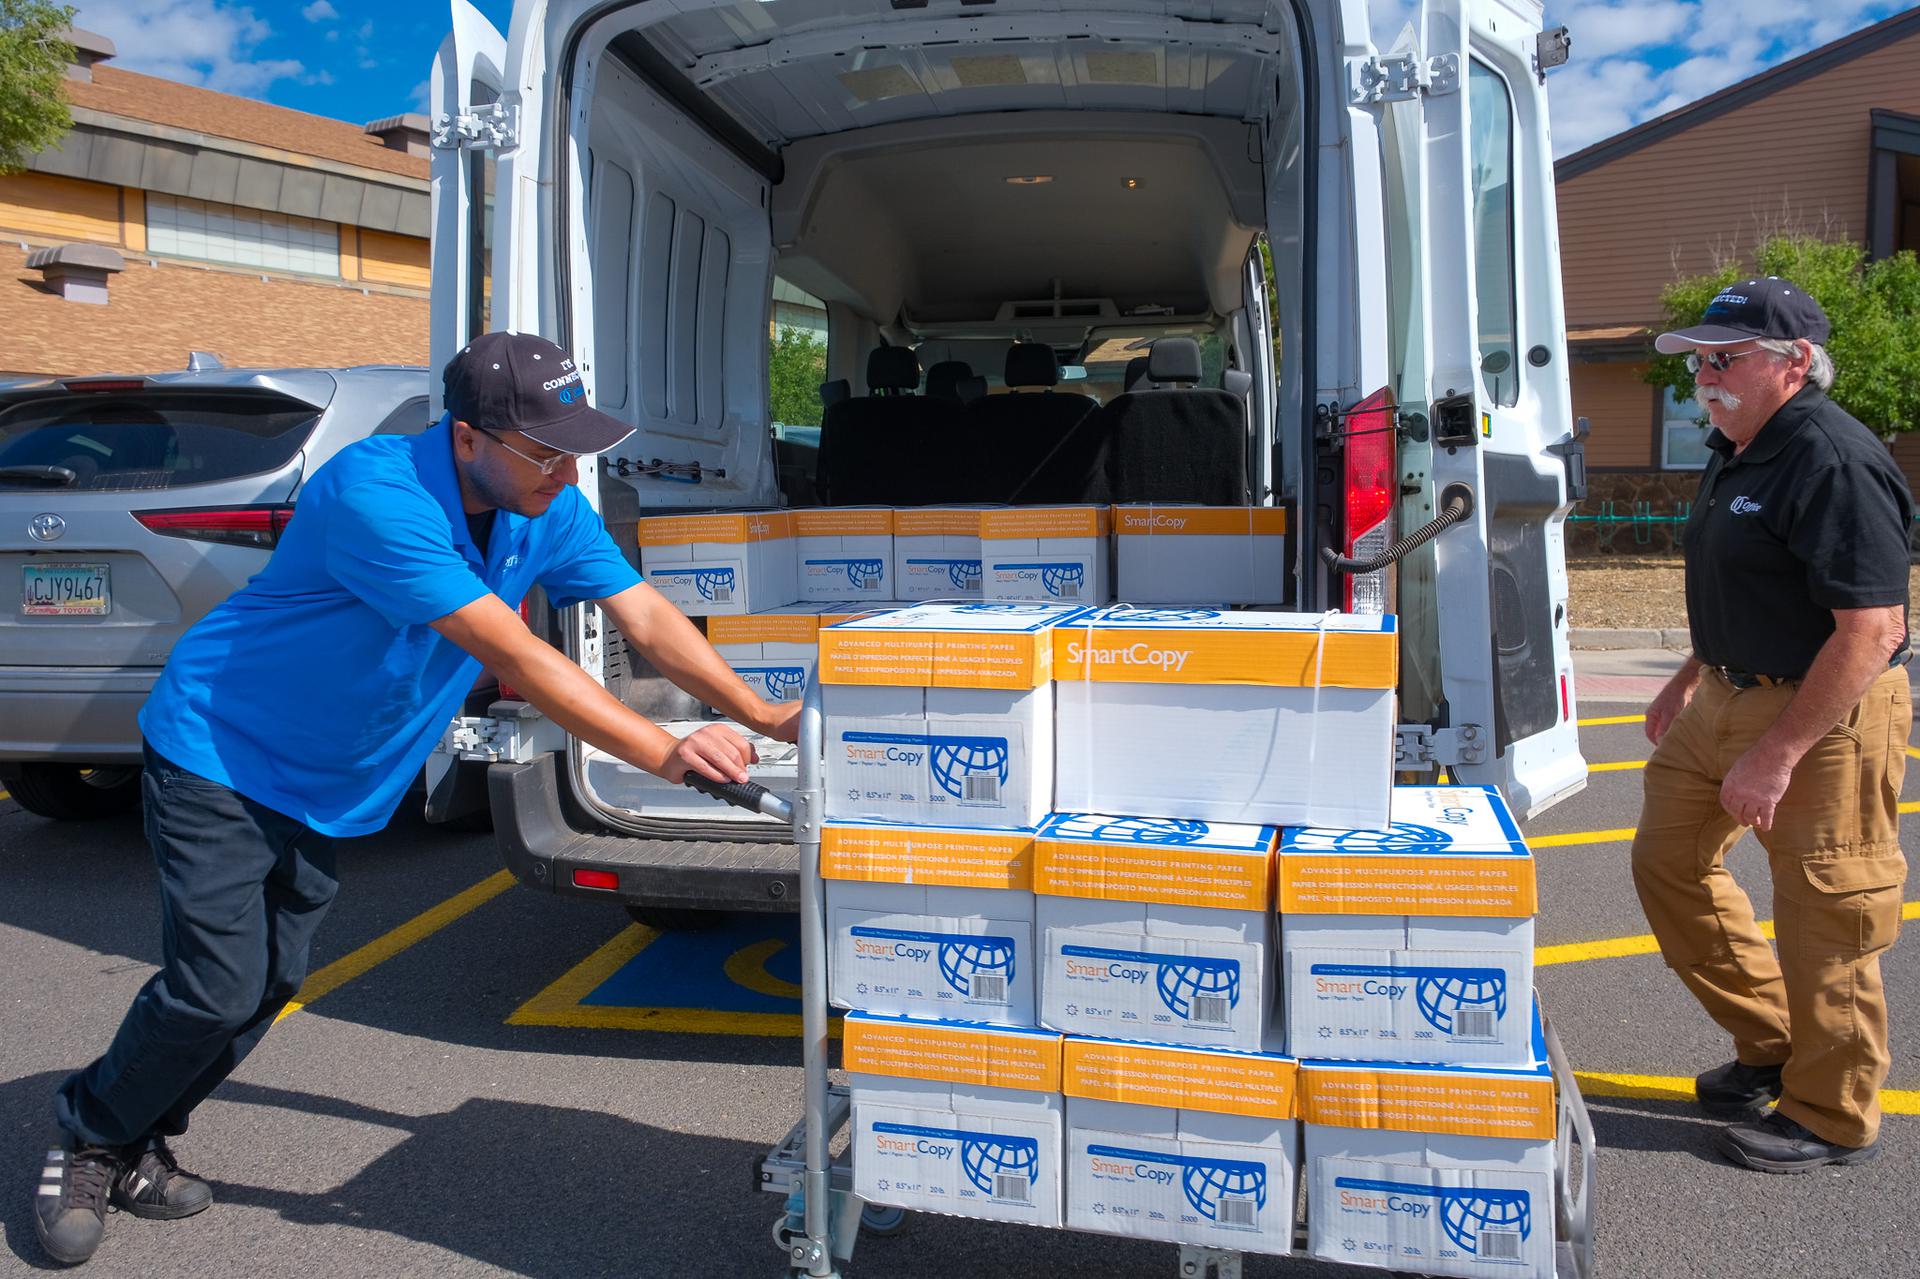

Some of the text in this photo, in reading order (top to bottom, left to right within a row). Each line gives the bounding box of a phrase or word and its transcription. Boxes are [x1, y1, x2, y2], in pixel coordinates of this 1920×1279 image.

[1124, 514, 1186, 529] SmartCopy
[652, 576, 692, 586] SmartCopy
[808, 566, 844, 576] SmartCopy
[908, 566, 946, 576] SmartCopy
[994, 570, 1038, 581] SmartCopy
[34, 577, 102, 600] CJY9467
[884, 641, 943, 649] MULTIPURPOSE
[946, 642, 987, 650] PRINTING
[1066, 642, 1190, 672] SmartCopy
[847, 744, 924, 766] SmartCopy
[837, 838, 880, 846] ADVANCED
[946, 844, 984, 852] PRINTING
[1052, 852, 1243, 872] ADVANCED MULTIPURPOSE PRINTING PAPER
[1301, 867, 1351, 875] ADVANCED
[1355, 868, 1424, 876] MULTIPURPOSE
[1479, 869, 1508, 877] PAPER
[855, 939, 932, 962] SmartCopy
[1066, 960, 1148, 984] SmartCopy
[1316, 978, 1408, 1000] SmartCopy
[1154, 1014, 1171, 1022] 5000
[862, 1033, 1037, 1056] ADVANCED MULTIPURPOSE PRINTING PAPER
[1084, 1052, 1275, 1078] ADVANCED MULTIPURPOSE PRINTING PAPER
[1322, 1081, 1530, 1099] ADVANCED MULTIPURPOSE PRINTING PAPER
[877, 1135, 954, 1160] SmartCopy
[1092, 1158, 1176, 1185] SmartCopy
[1340, 1191, 1431, 1218] SmartCopy
[1439, 1250, 1458, 1258] 5000
